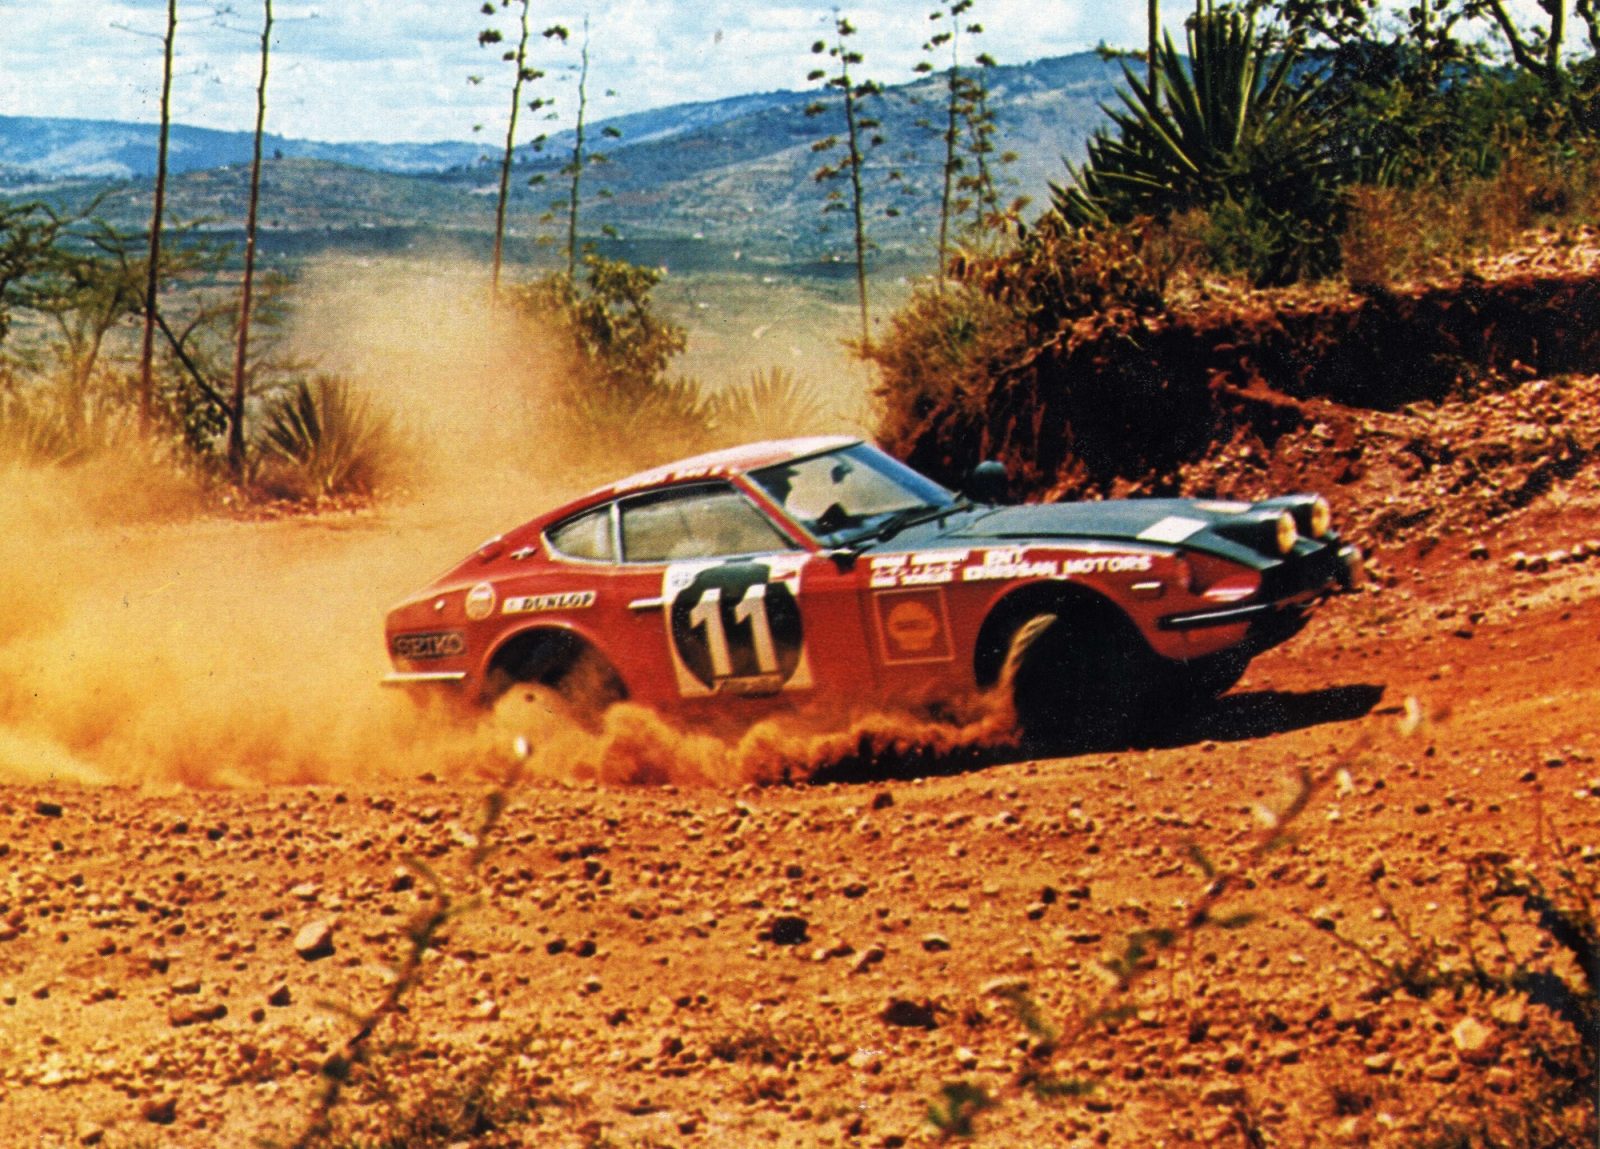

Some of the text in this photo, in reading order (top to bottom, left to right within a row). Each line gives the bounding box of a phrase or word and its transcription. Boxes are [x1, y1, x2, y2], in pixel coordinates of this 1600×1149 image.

[1064, 555, 1153, 576] MOTORS
[522, 592, 594, 611] DUNLOP
[689, 584, 779, 676] 11
[396, 632, 464, 657] SEIKO
